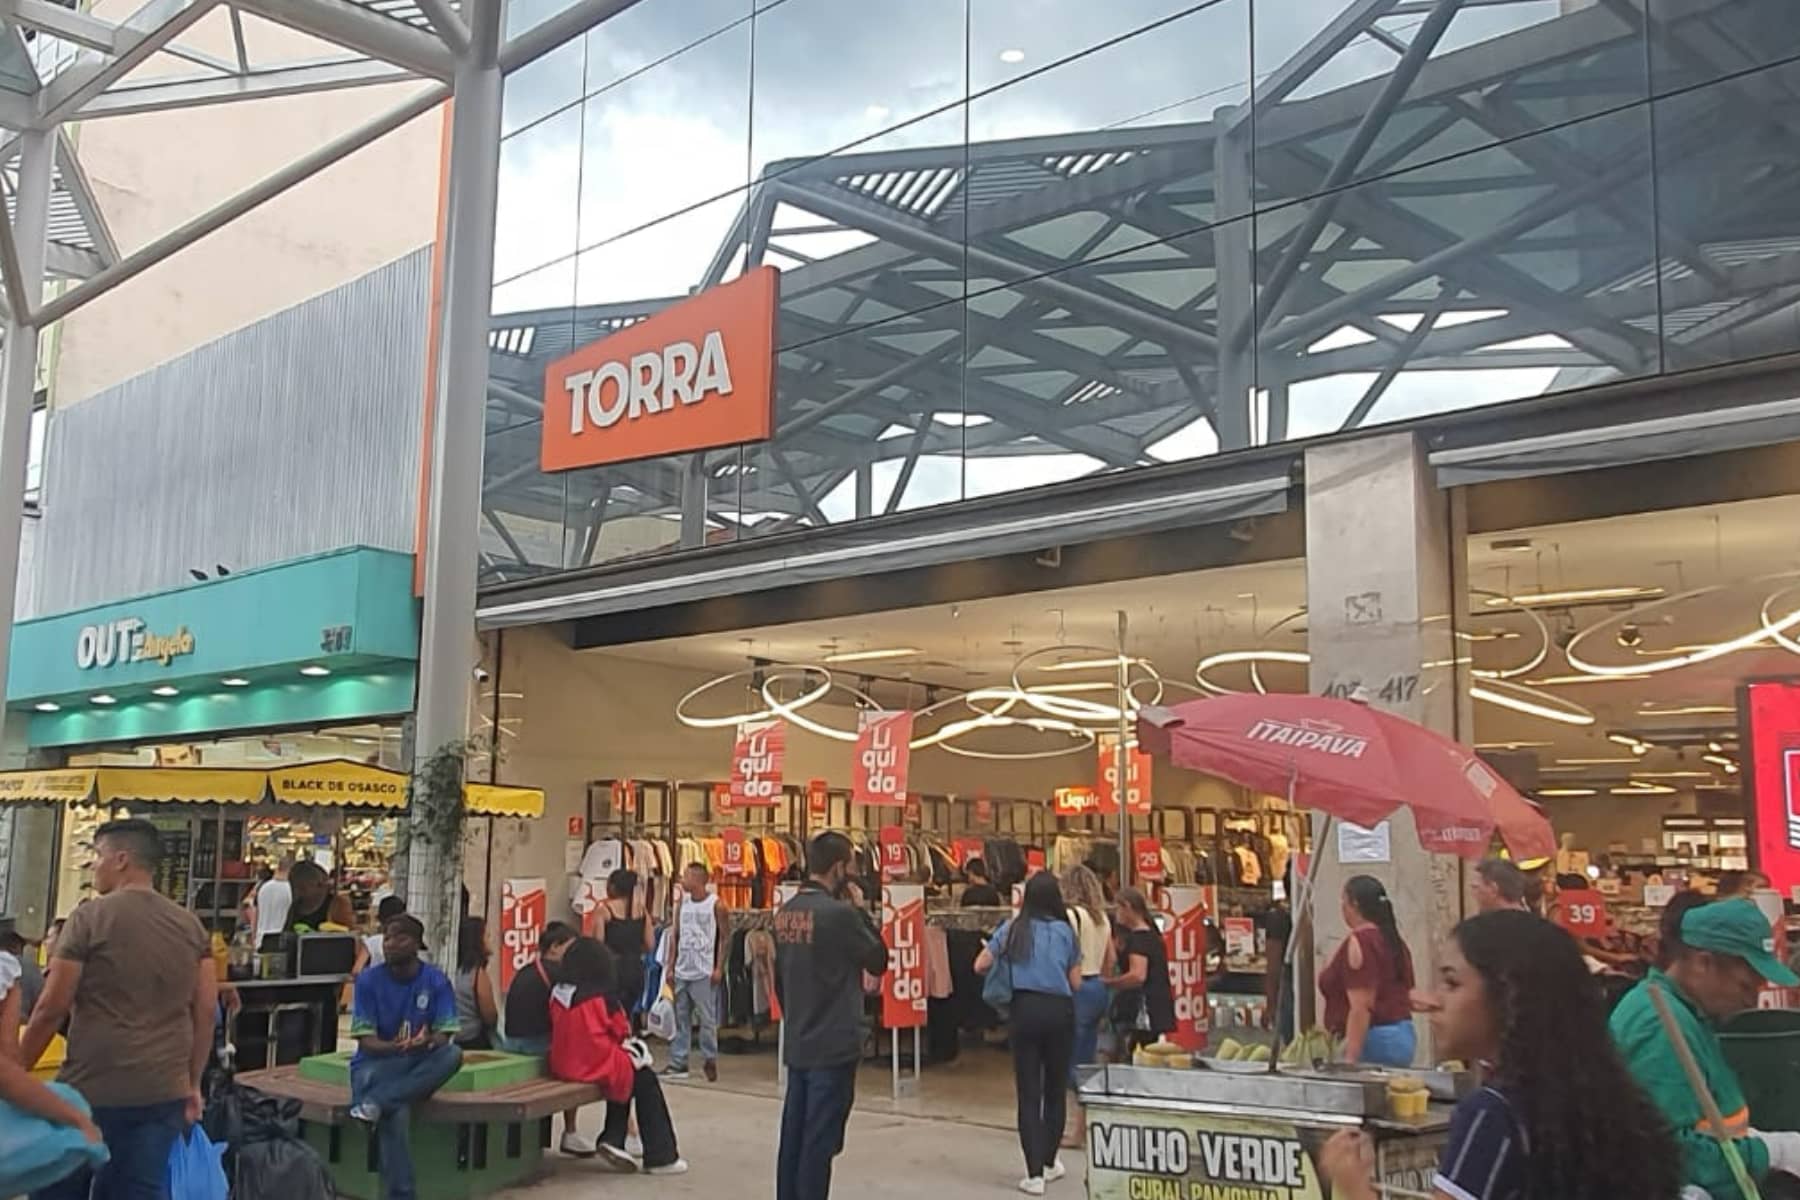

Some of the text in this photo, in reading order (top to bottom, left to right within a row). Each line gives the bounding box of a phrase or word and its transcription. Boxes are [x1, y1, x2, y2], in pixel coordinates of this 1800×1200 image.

[565, 331, 733, 435] TORRA
[1379, 676, 1418, 702] 417
[1247, 721, 1368, 758] ITAIPAVA
[282, 779, 397, 794] BLACK DE OSASCO
[727, 842, 741, 862] 19
[886, 843, 901, 861] 19
[1569, 904, 1596, 924] 39
[1092, 1124, 1304, 1187] MILHO VERDE
[1130, 1176, 1183, 1200] CURAL
